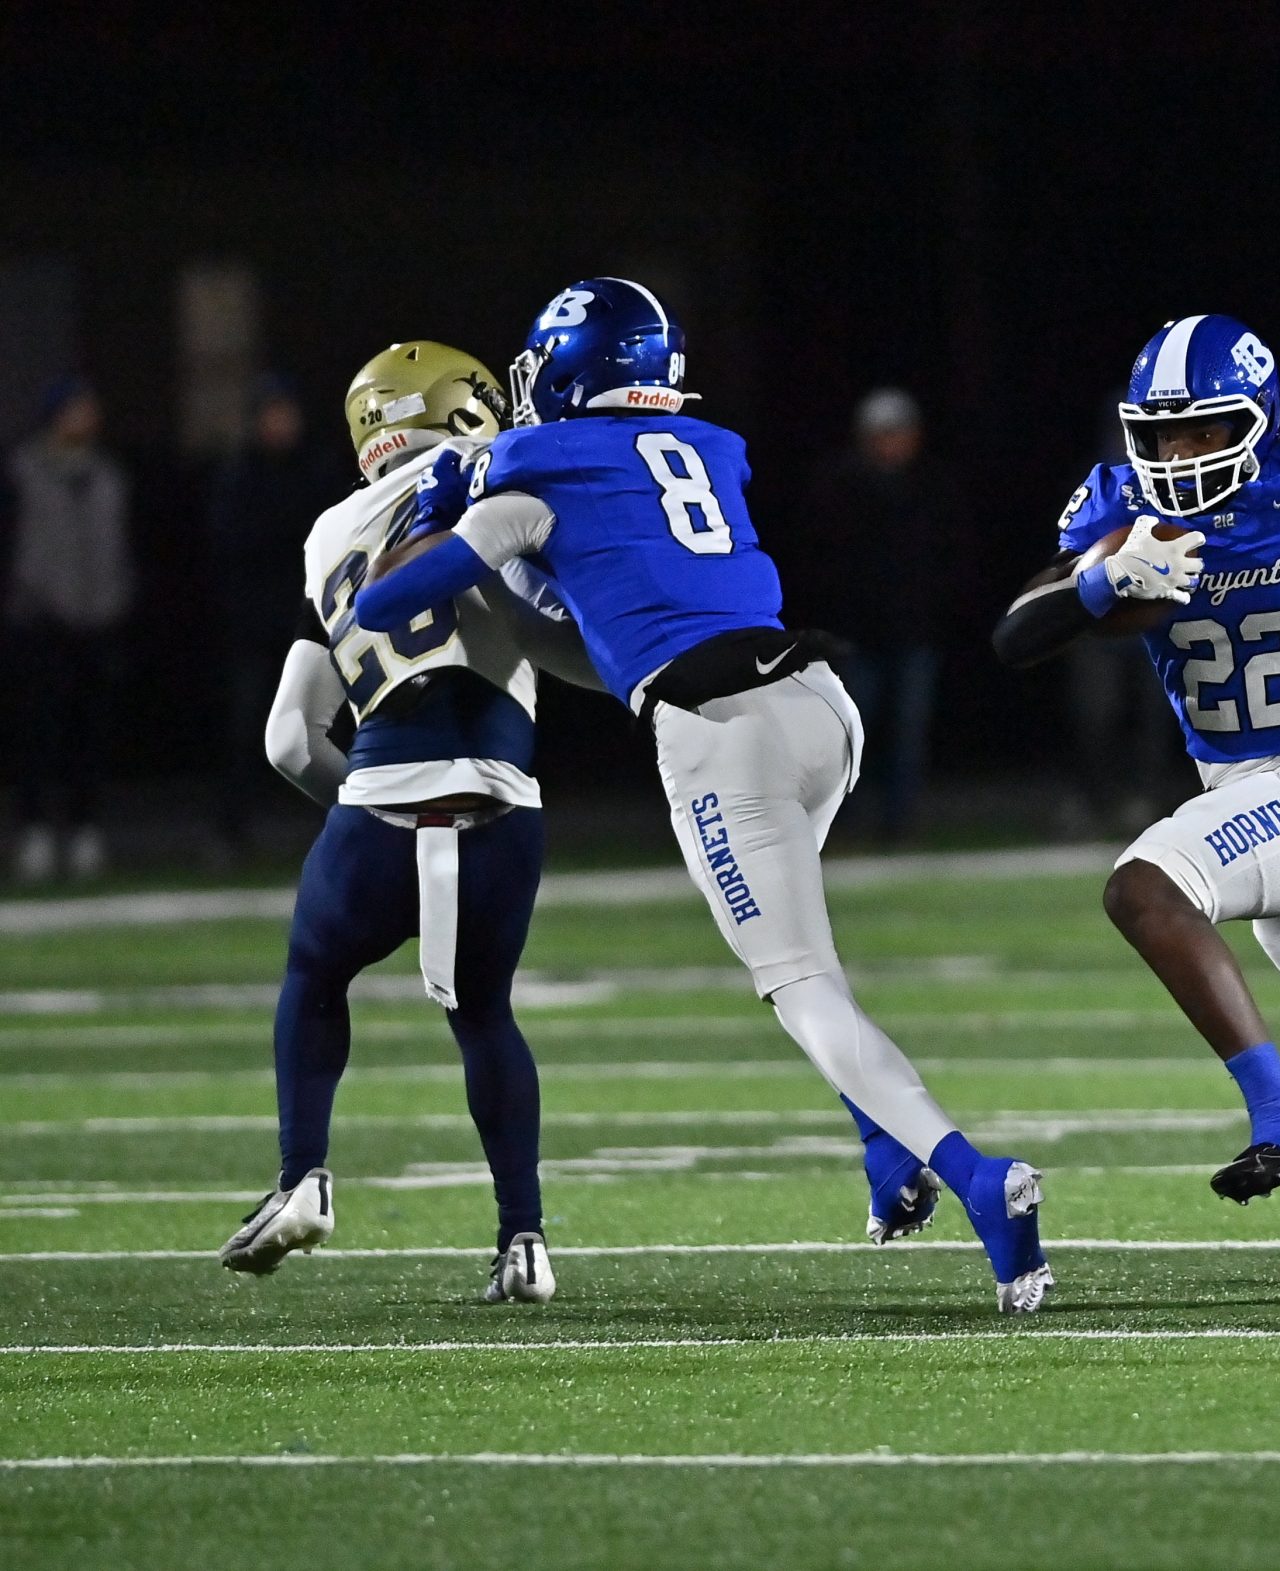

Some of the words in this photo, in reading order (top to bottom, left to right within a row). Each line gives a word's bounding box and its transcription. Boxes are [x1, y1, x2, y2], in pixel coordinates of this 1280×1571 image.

[1230, 332, 1275, 388] B
[1158, 400, 1177, 408] VICIS
[1171, 388, 1185, 396] BEST
[367, 408, 383, 426] 20
[468, 451, 492, 500] 8
[634, 431, 735, 555] 8
[1213, 512, 1235, 529] 212
[691, 791, 762, 926] HORNETS
